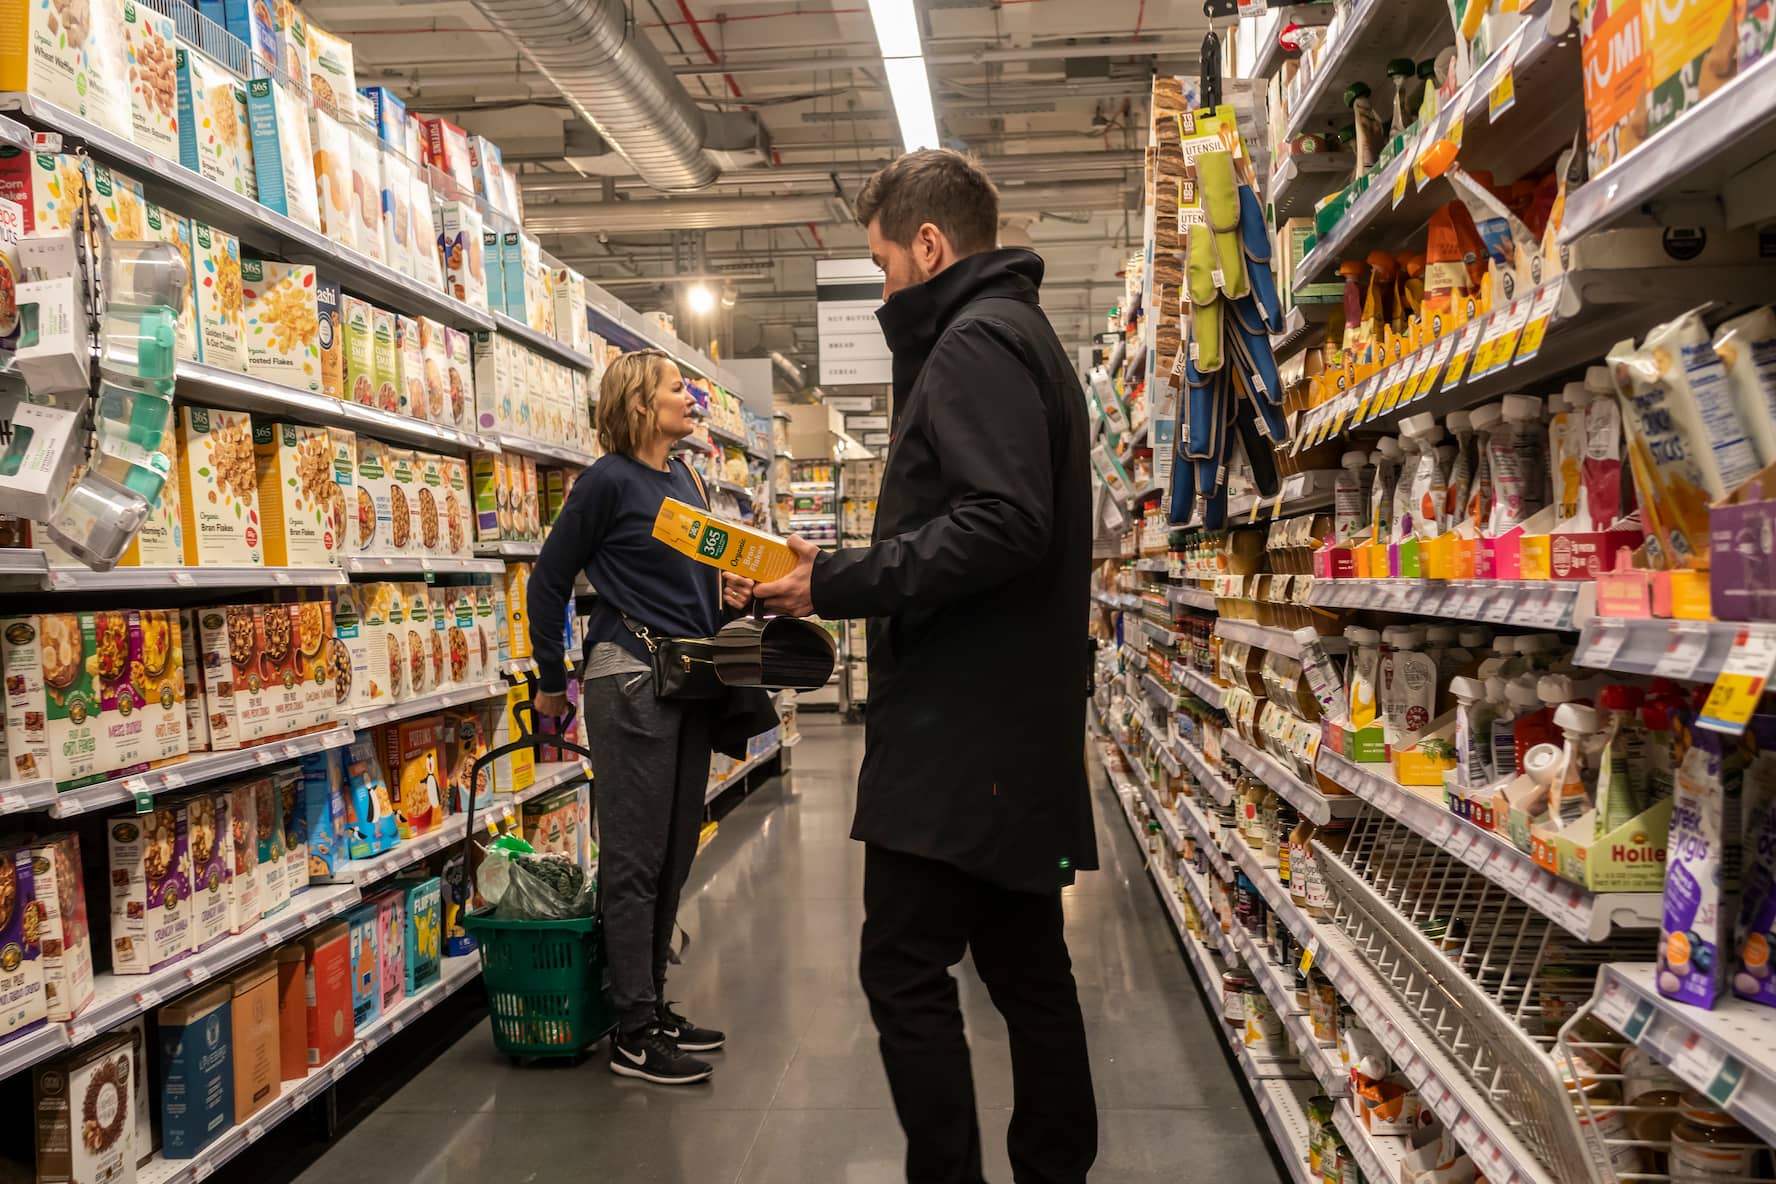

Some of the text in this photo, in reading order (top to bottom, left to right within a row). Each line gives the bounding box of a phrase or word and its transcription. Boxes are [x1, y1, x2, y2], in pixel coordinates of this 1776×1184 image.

[1584, 14, 1642, 101] YUMI
[251, 82, 268, 91] 365
[1182, 113, 1192, 121] TO
[1185, 139, 1224, 156] UTENSIL
[1181, 214, 1205, 225] UTEN
[242, 262, 261, 274] 365
[317, 287, 337, 306] ashi
[248, 356, 294, 366] rosted Flakes
[193, 409, 208, 424] 365
[254, 427, 272, 438] 365
[201, 523, 233, 532] Bran Flakes
[290, 528, 301, 536] Bran
[704, 530, 721, 555] 365
[730, 538, 747, 568] Organic
[742, 545, 757, 567] Bran
[750, 544, 765, 572] Flakes
[387, 729, 401, 767] PUFFINS
[1612, 844, 1666, 863] Holle
